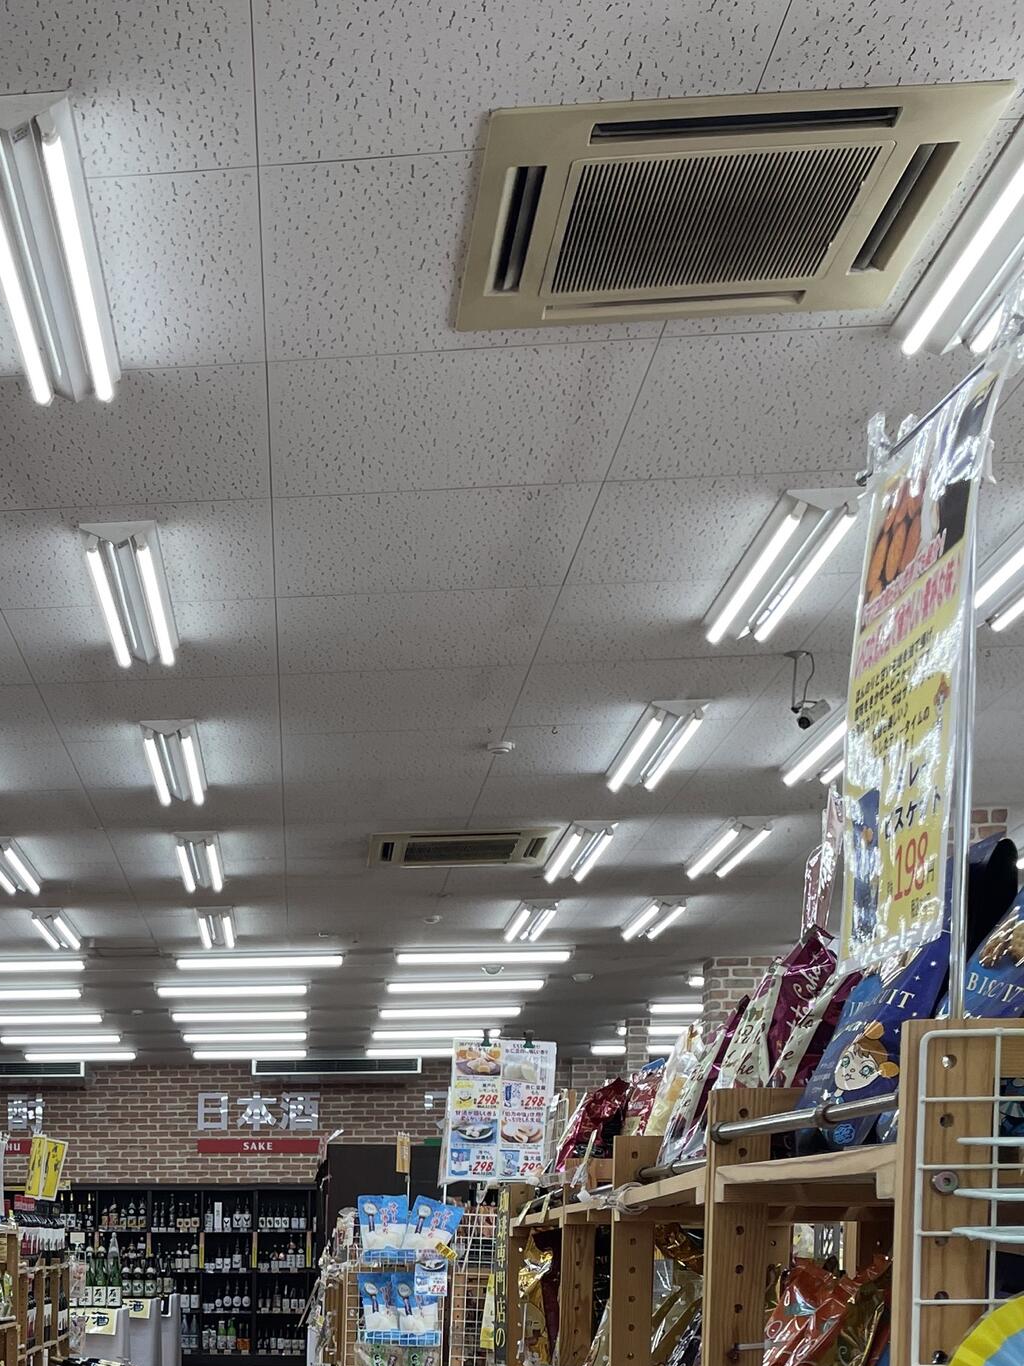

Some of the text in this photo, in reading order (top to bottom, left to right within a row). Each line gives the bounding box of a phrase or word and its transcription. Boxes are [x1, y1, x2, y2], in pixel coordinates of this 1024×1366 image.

[894, 831, 929, 901] 198
[477, 1093, 499, 1105] 298
[524, 1096, 545, 1107] 298
[197, 1092, 320, 1131] 日本酒
[243, 1141, 274, 1151] SAKE
[472, 1161, 494, 1172] 298
